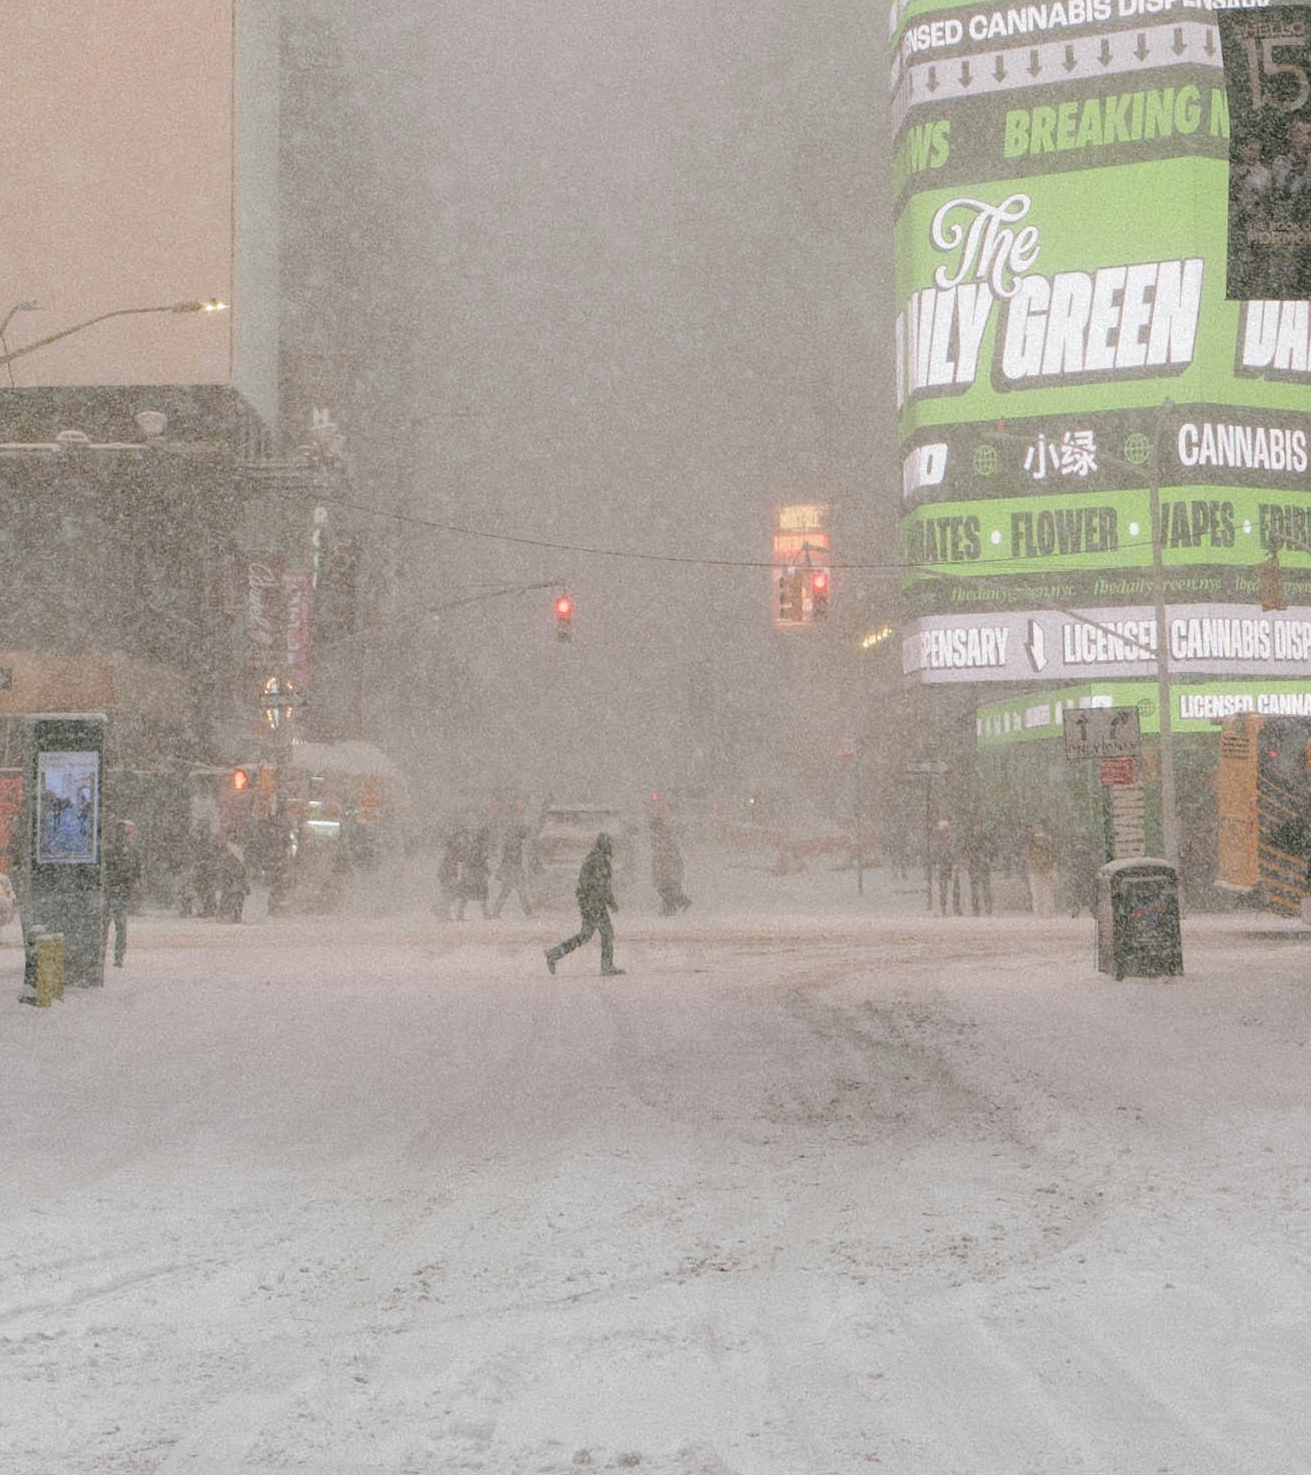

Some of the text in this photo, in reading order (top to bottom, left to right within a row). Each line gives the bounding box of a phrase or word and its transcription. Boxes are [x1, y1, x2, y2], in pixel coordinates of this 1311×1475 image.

[1244, 36, 1310, 113] 15
[1003, 83, 1202, 158] BREAKING
[931, 193, 1041, 298] The
[1000, 257, 1205, 381] GREEN
[1178, 423, 1308, 473] CANNABIS
[1010, 506, 1119, 558] FLOWER
[1170, 616, 1271, 662] CANNABIS
[1180, 693, 1253, 719] LICENSED
